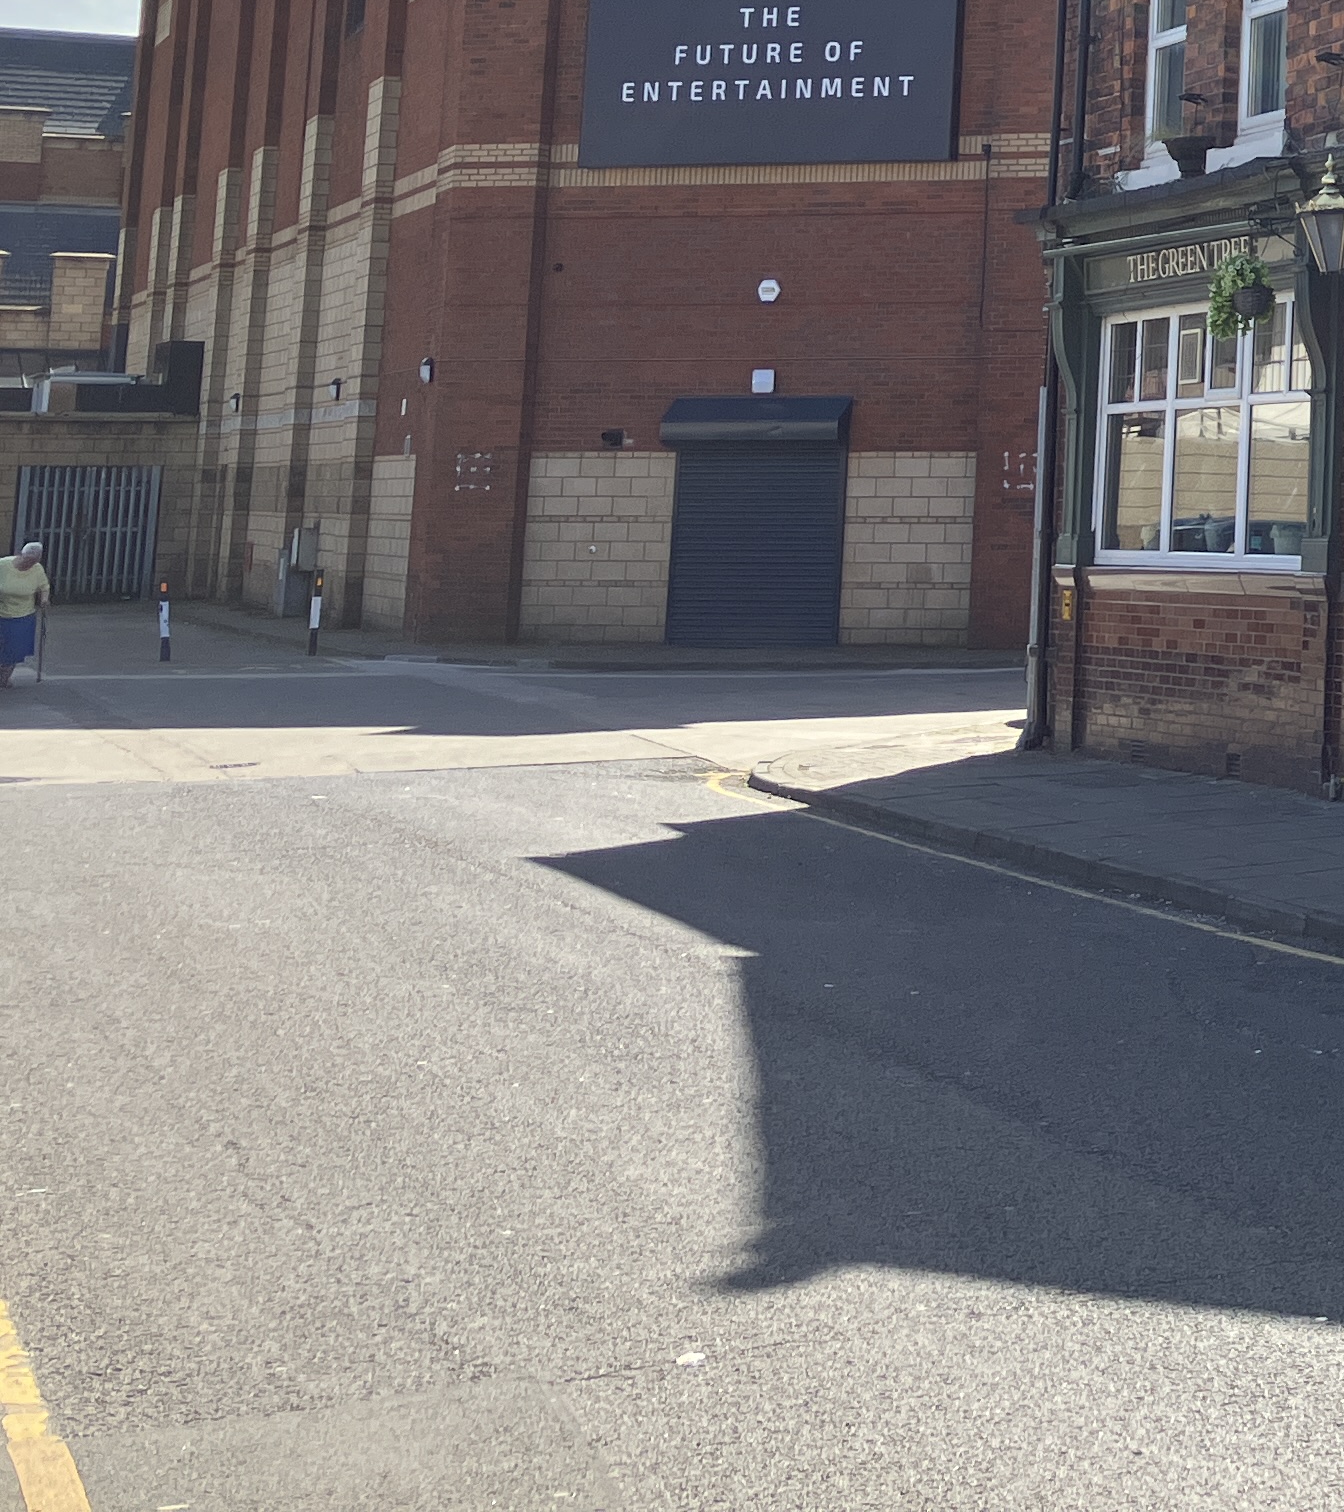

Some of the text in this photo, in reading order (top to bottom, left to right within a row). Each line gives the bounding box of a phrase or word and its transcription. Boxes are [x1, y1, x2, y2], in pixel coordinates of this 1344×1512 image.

[740, 6, 802, 29] THE
[674, 40, 865, 66] FUTURE OF
[620, 75, 915, 104] ENTERTAINMENT
[1127, 252, 1158, 283] THE
[1158, 242, 1208, 277] GREEN
